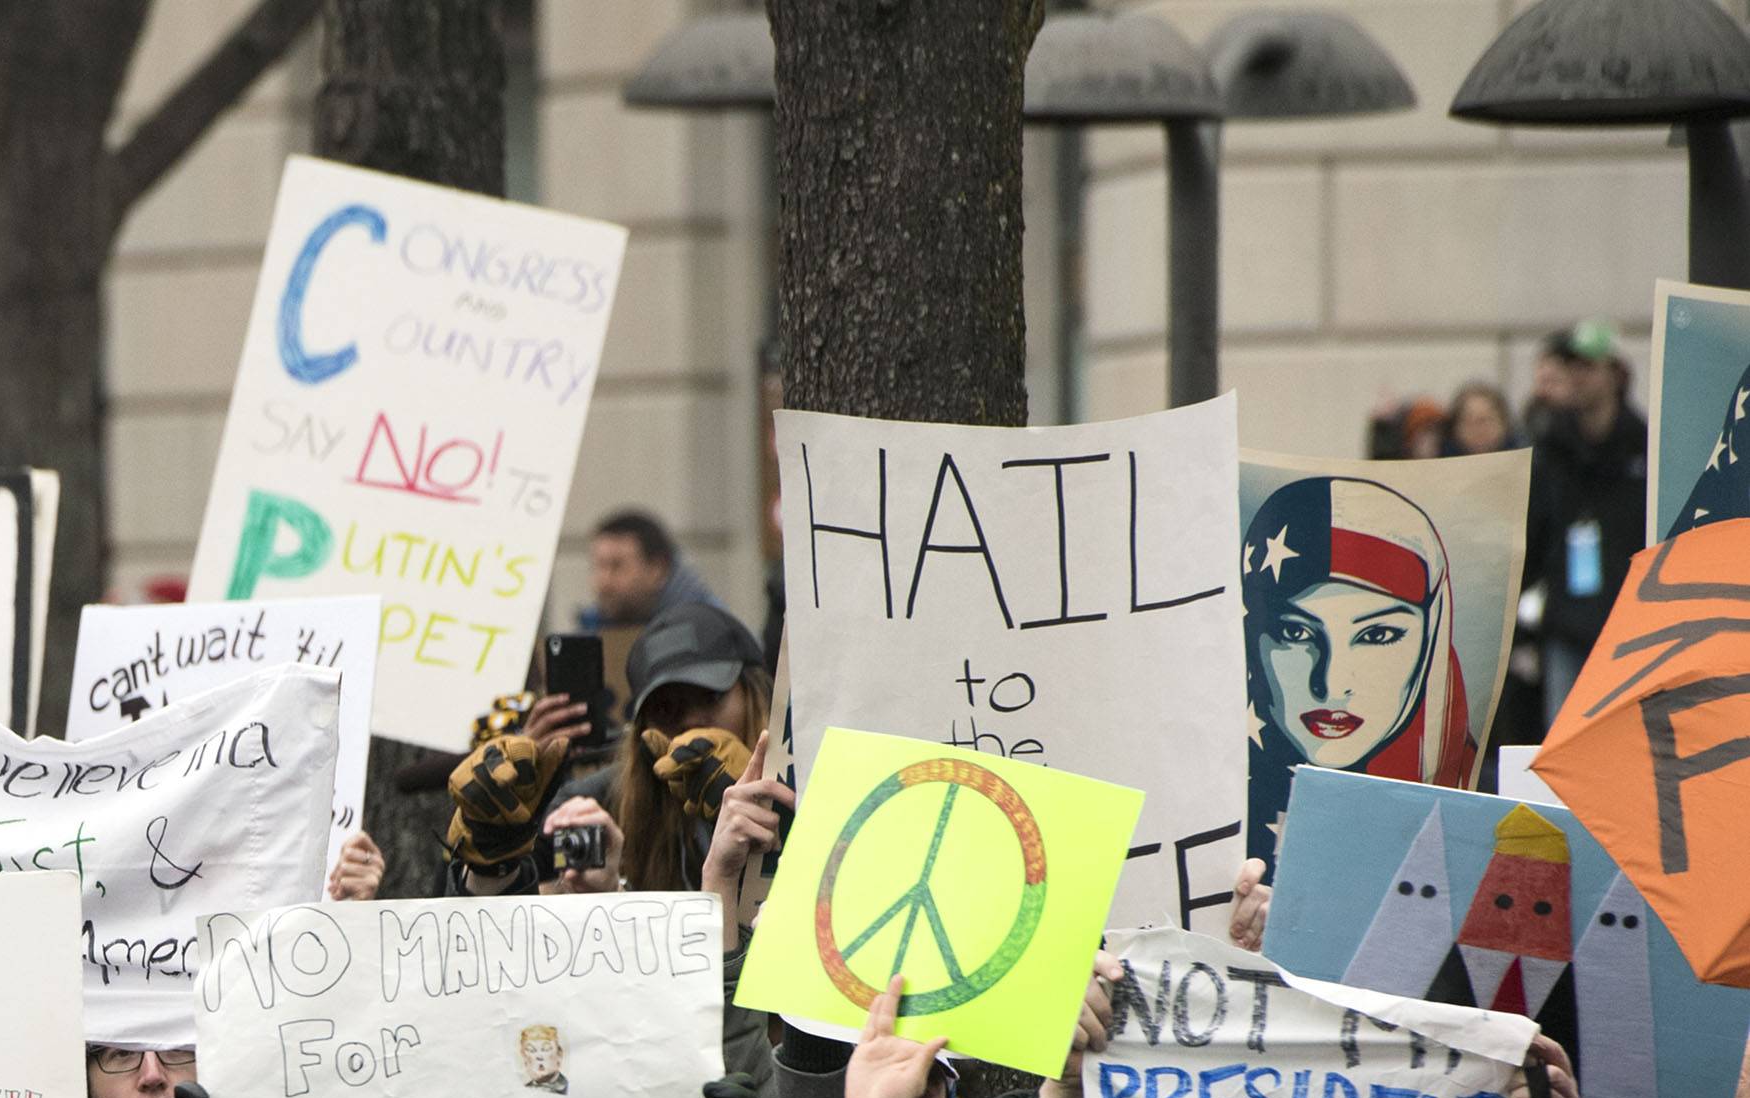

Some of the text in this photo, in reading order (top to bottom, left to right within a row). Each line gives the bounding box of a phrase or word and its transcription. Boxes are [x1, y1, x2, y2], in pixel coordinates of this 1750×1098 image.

[252, 402, 554, 518] SAY NO! TO
[801, 442, 1226, 630] HAIL
[176, 610, 266, 669] wait
[955, 659, 1036, 712] to
[228, 721, 279, 769] a
[146, 815, 203, 890] &
[201, 899, 714, 1013] NO MANDATE
[1108, 957, 1292, 1055] NOT
[277, 1018, 422, 1098] For
